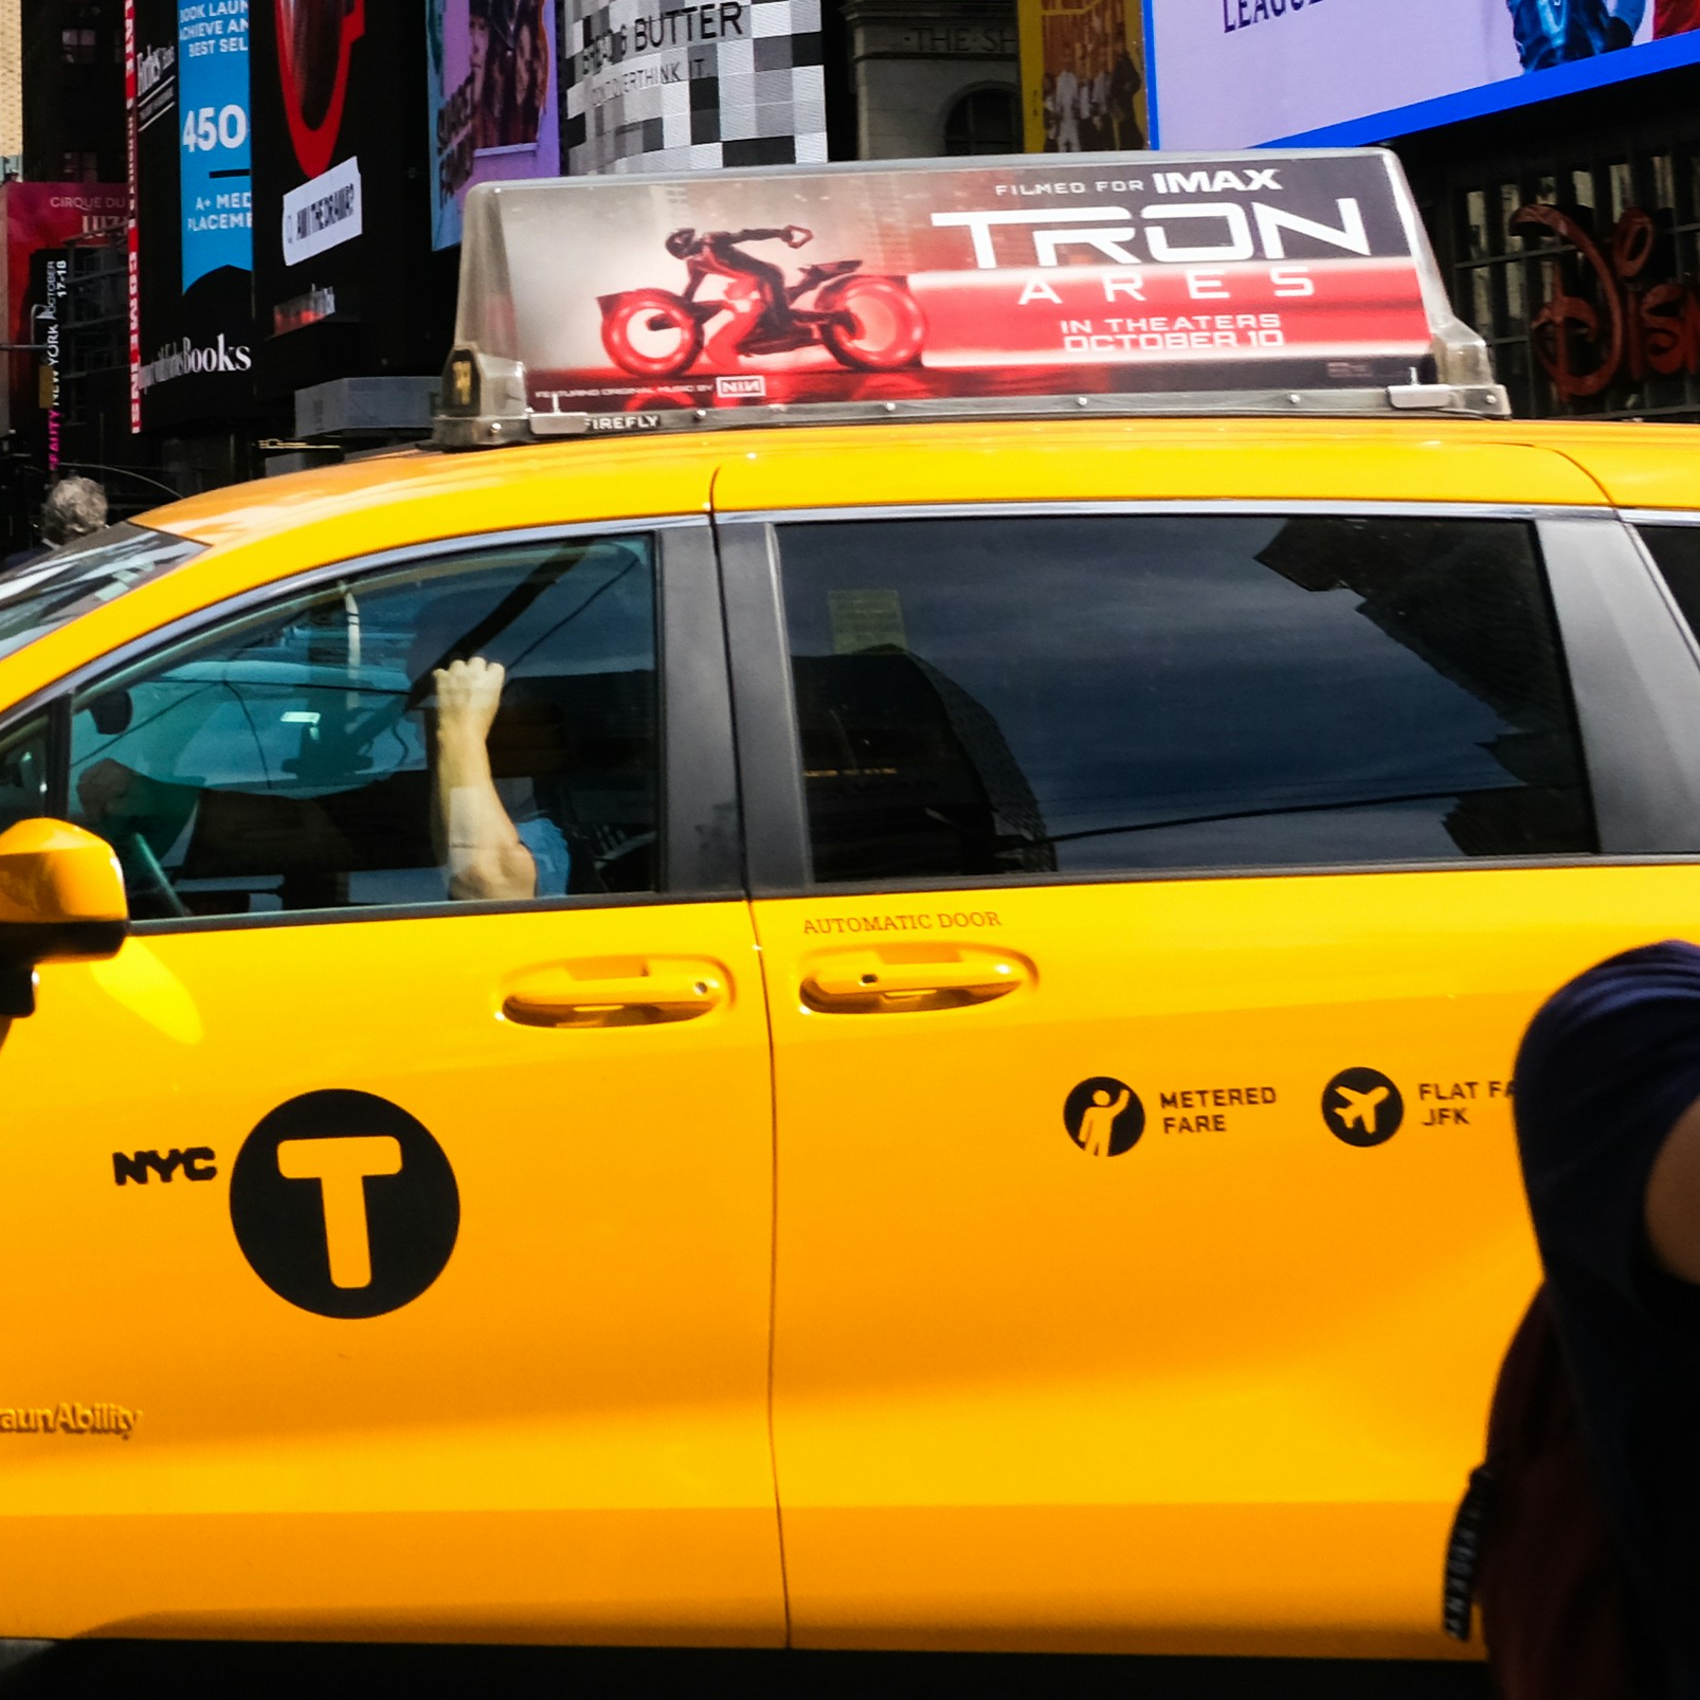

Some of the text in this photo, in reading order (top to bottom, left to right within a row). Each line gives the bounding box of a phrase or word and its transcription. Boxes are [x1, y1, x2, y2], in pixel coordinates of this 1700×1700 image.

[634, 0, 743, 52] BUTTER
[995, 168, 1284, 198] FILMED FOR IMAX
[49, 197, 127, 211] CIRQUE DU
[930, 197, 1371, 269] TRON
[1017, 268, 1316, 307] ARES
[1060, 314, 1281, 334] IN THEATERS
[47, 323, 60, 367] YORK
[1063, 330, 1285, 354] OCTOBER 10
[803, 911, 1003, 936] AUTOMATIC DOOR
[1158, 1086, 1278, 1112] METERED
[1417, 1082, 1472, 1103] FLAT
[1161, 1107, 1470, 1135] FARE JFK
[113, 1148, 218, 1187] NYC
[294, 1135, 403, 1288] T
